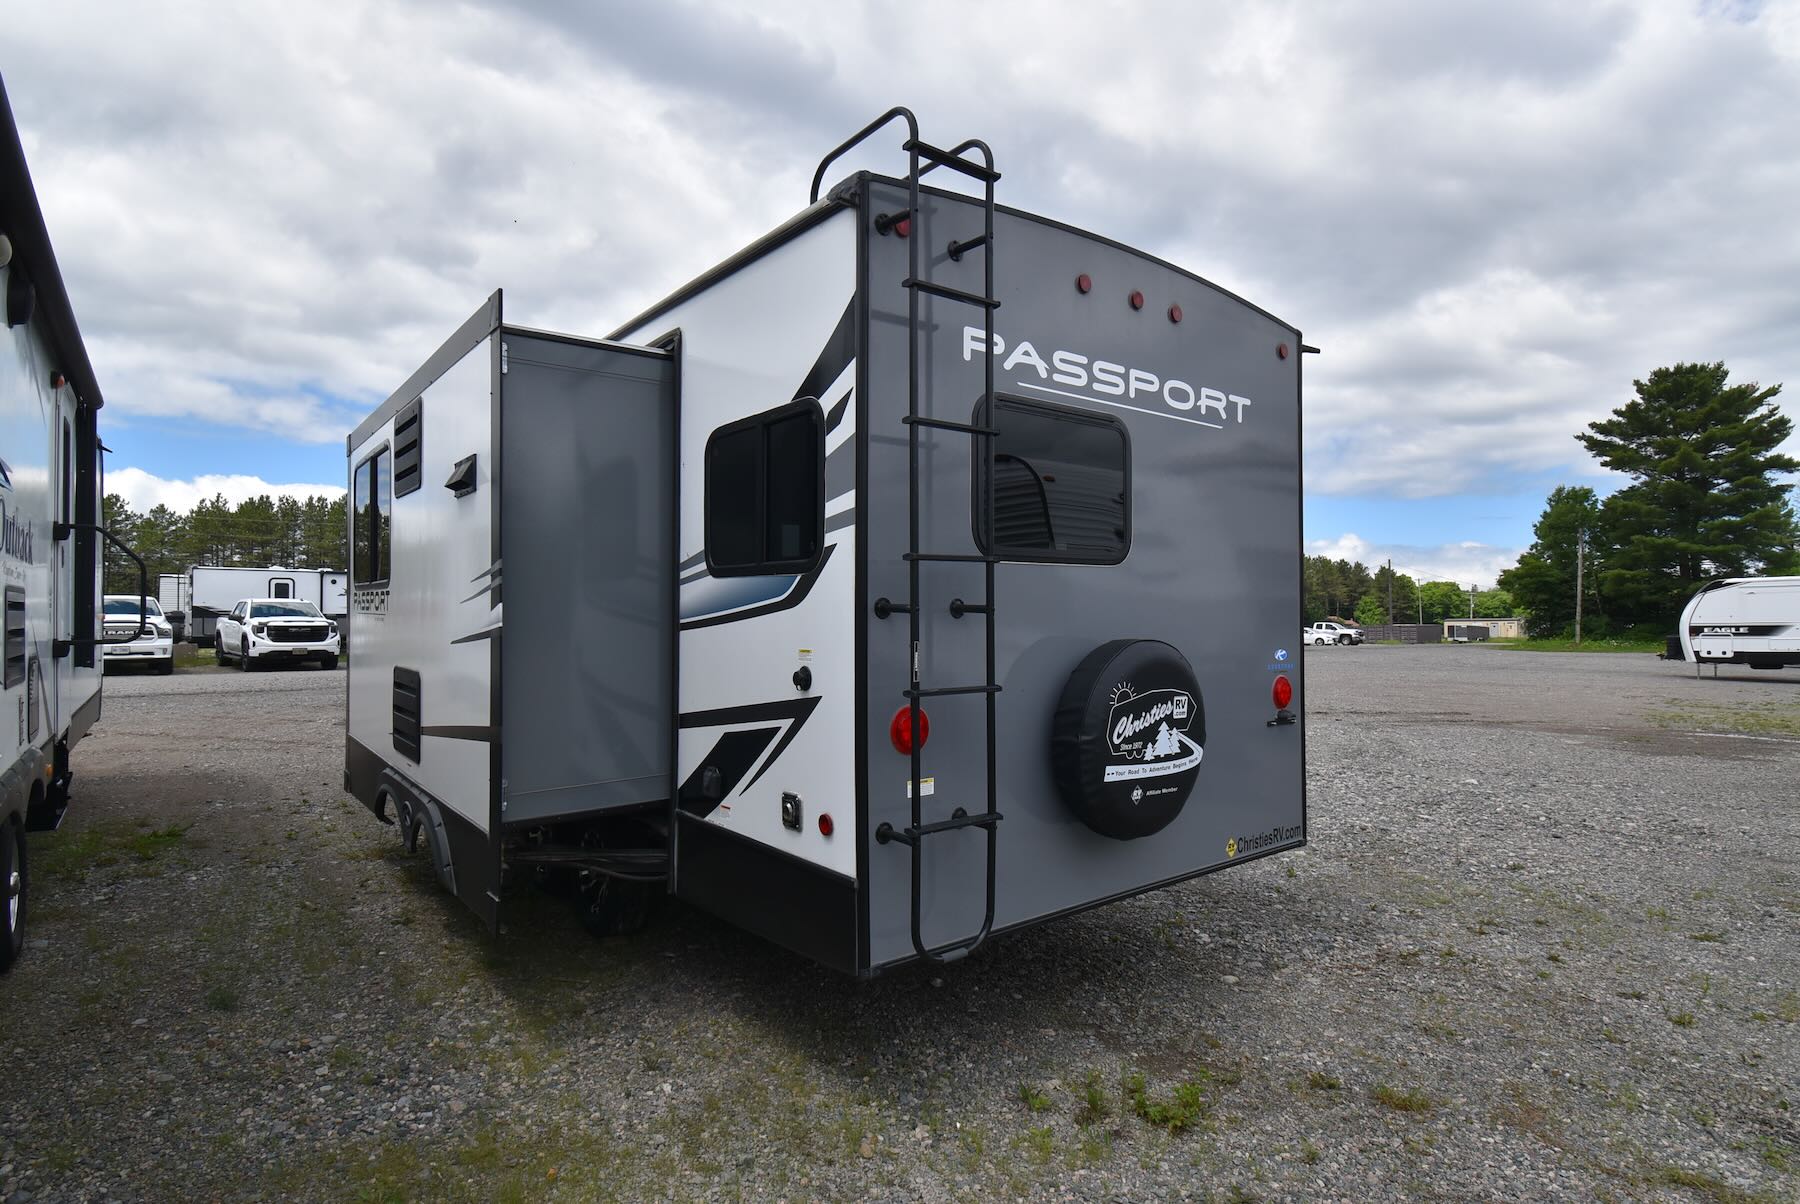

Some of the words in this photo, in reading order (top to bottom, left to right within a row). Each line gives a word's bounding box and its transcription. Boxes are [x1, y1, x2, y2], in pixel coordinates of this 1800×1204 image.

[963, 326, 1251, 424] PASSPORT
[354, 591, 390, 611] PASSPORT
[1175, 698, 1187, 710] RV
[1112, 700, 1173, 745] Christies
[1148, 765, 1171, 773] Adventure
[1162, 786, 1178, 794] Member
[1237, 825, 1302, 854] ChristiesRV.com
